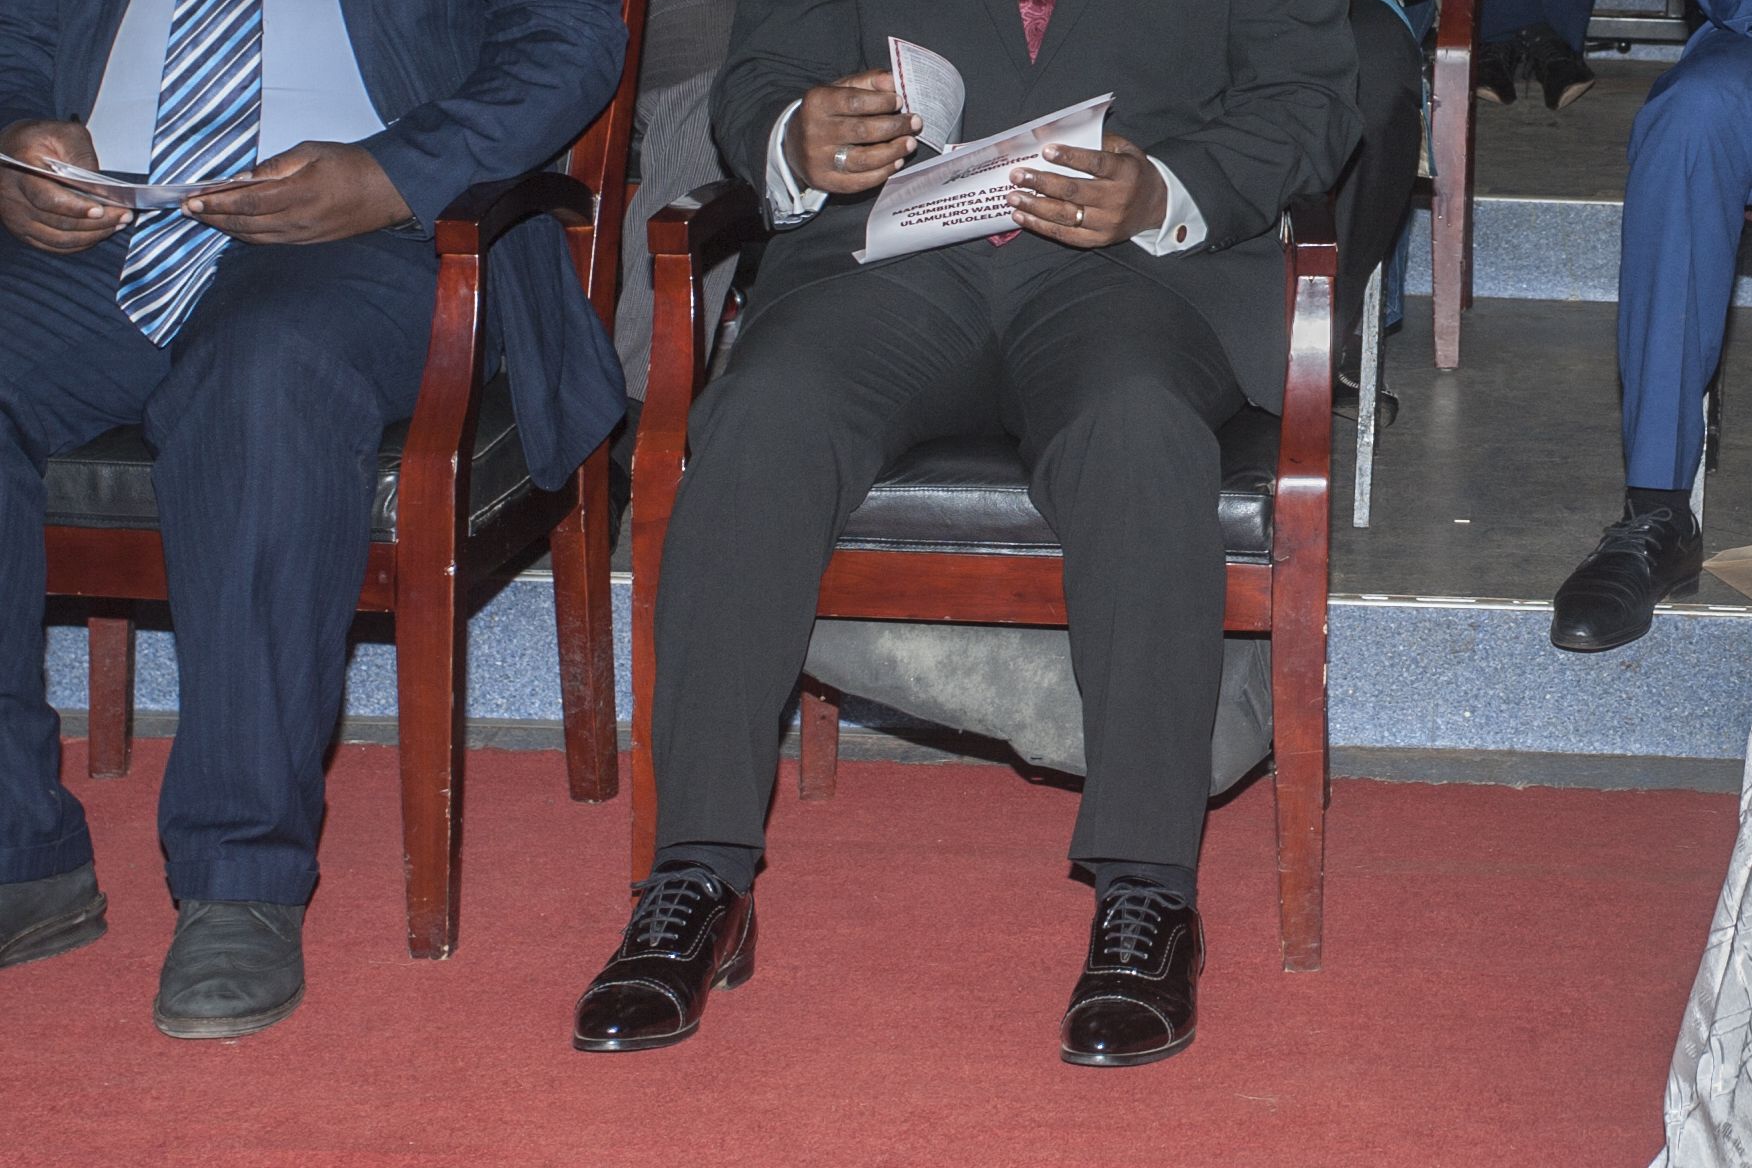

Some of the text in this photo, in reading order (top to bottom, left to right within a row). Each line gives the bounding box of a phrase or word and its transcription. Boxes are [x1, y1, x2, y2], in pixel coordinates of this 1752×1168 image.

[891, 191, 977, 216] MAPEMPHERO
[989, 184, 1020, 193] DZIK
[907, 197, 983, 218] OLIMBIKITSA
[900, 208, 969, 227] ULAMULIRO
[942, 210, 1012, 227] KULOLELAN
